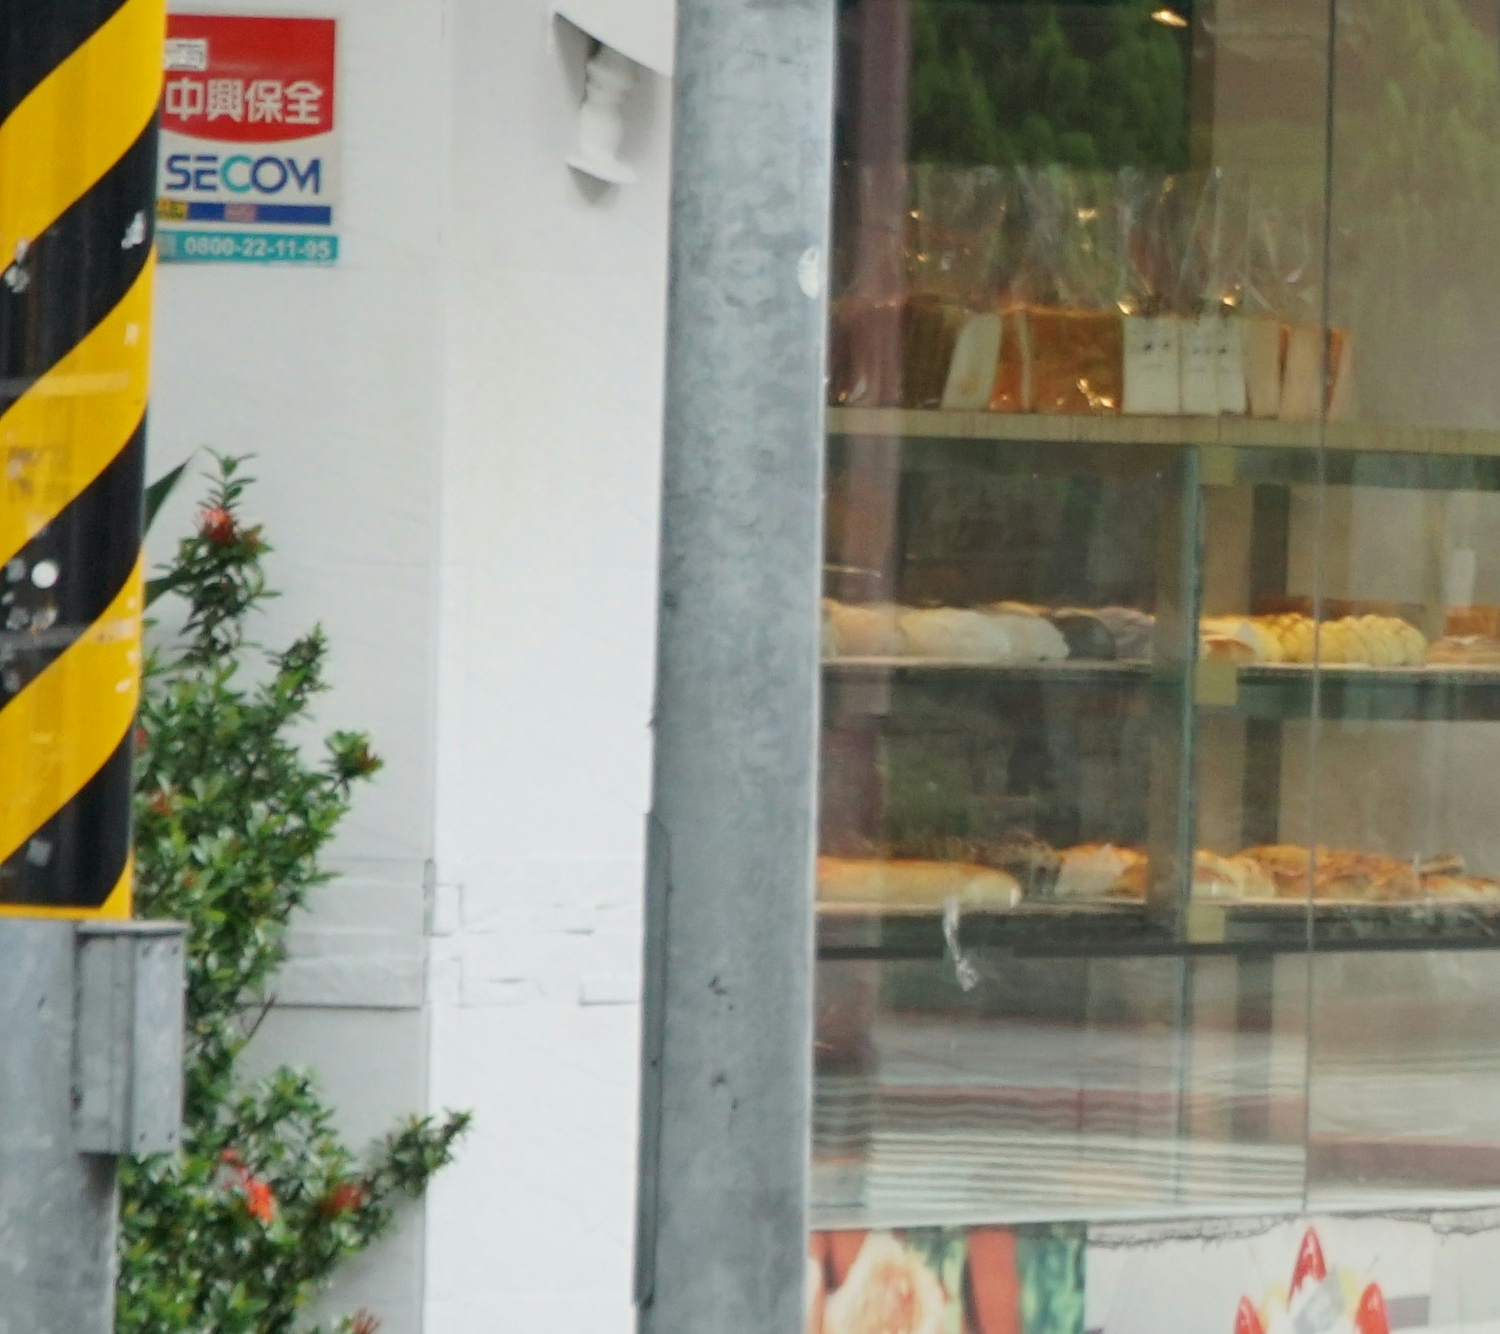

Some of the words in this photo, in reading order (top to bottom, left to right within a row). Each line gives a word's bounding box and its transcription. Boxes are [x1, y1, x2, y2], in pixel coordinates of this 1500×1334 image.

[164, 76, 324, 125] 中興保全
[164, 153, 322, 195] SECOM
